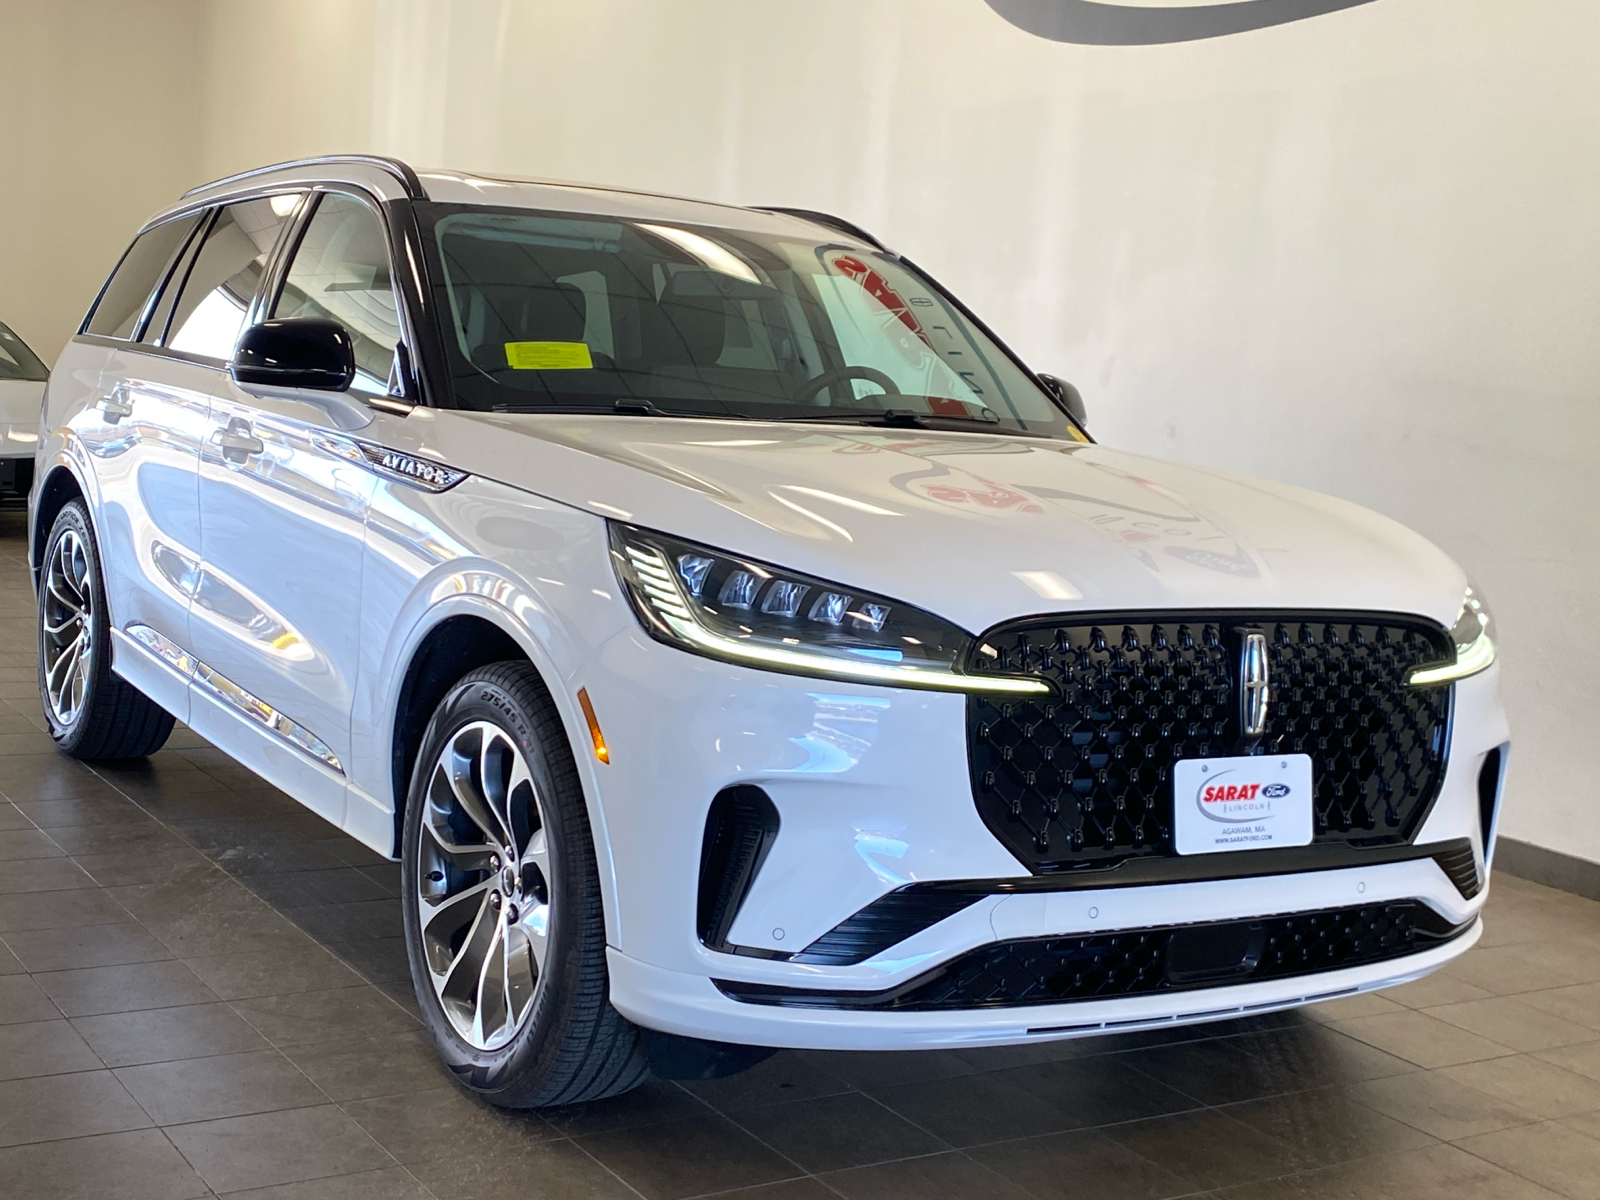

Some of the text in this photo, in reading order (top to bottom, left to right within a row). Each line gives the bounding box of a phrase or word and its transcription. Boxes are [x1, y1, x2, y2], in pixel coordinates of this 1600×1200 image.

[382, 453, 445, 485] AVIATOR
[481, 690, 518, 723] 275/45
[1202, 783, 1287, 803] SARAT Ford
[1228, 803, 1265, 812] LINCOLN
[1221, 827, 1253, 835] AGAWAM,
[1214, 834, 1273, 844] WWW.SARATFORD.COM
